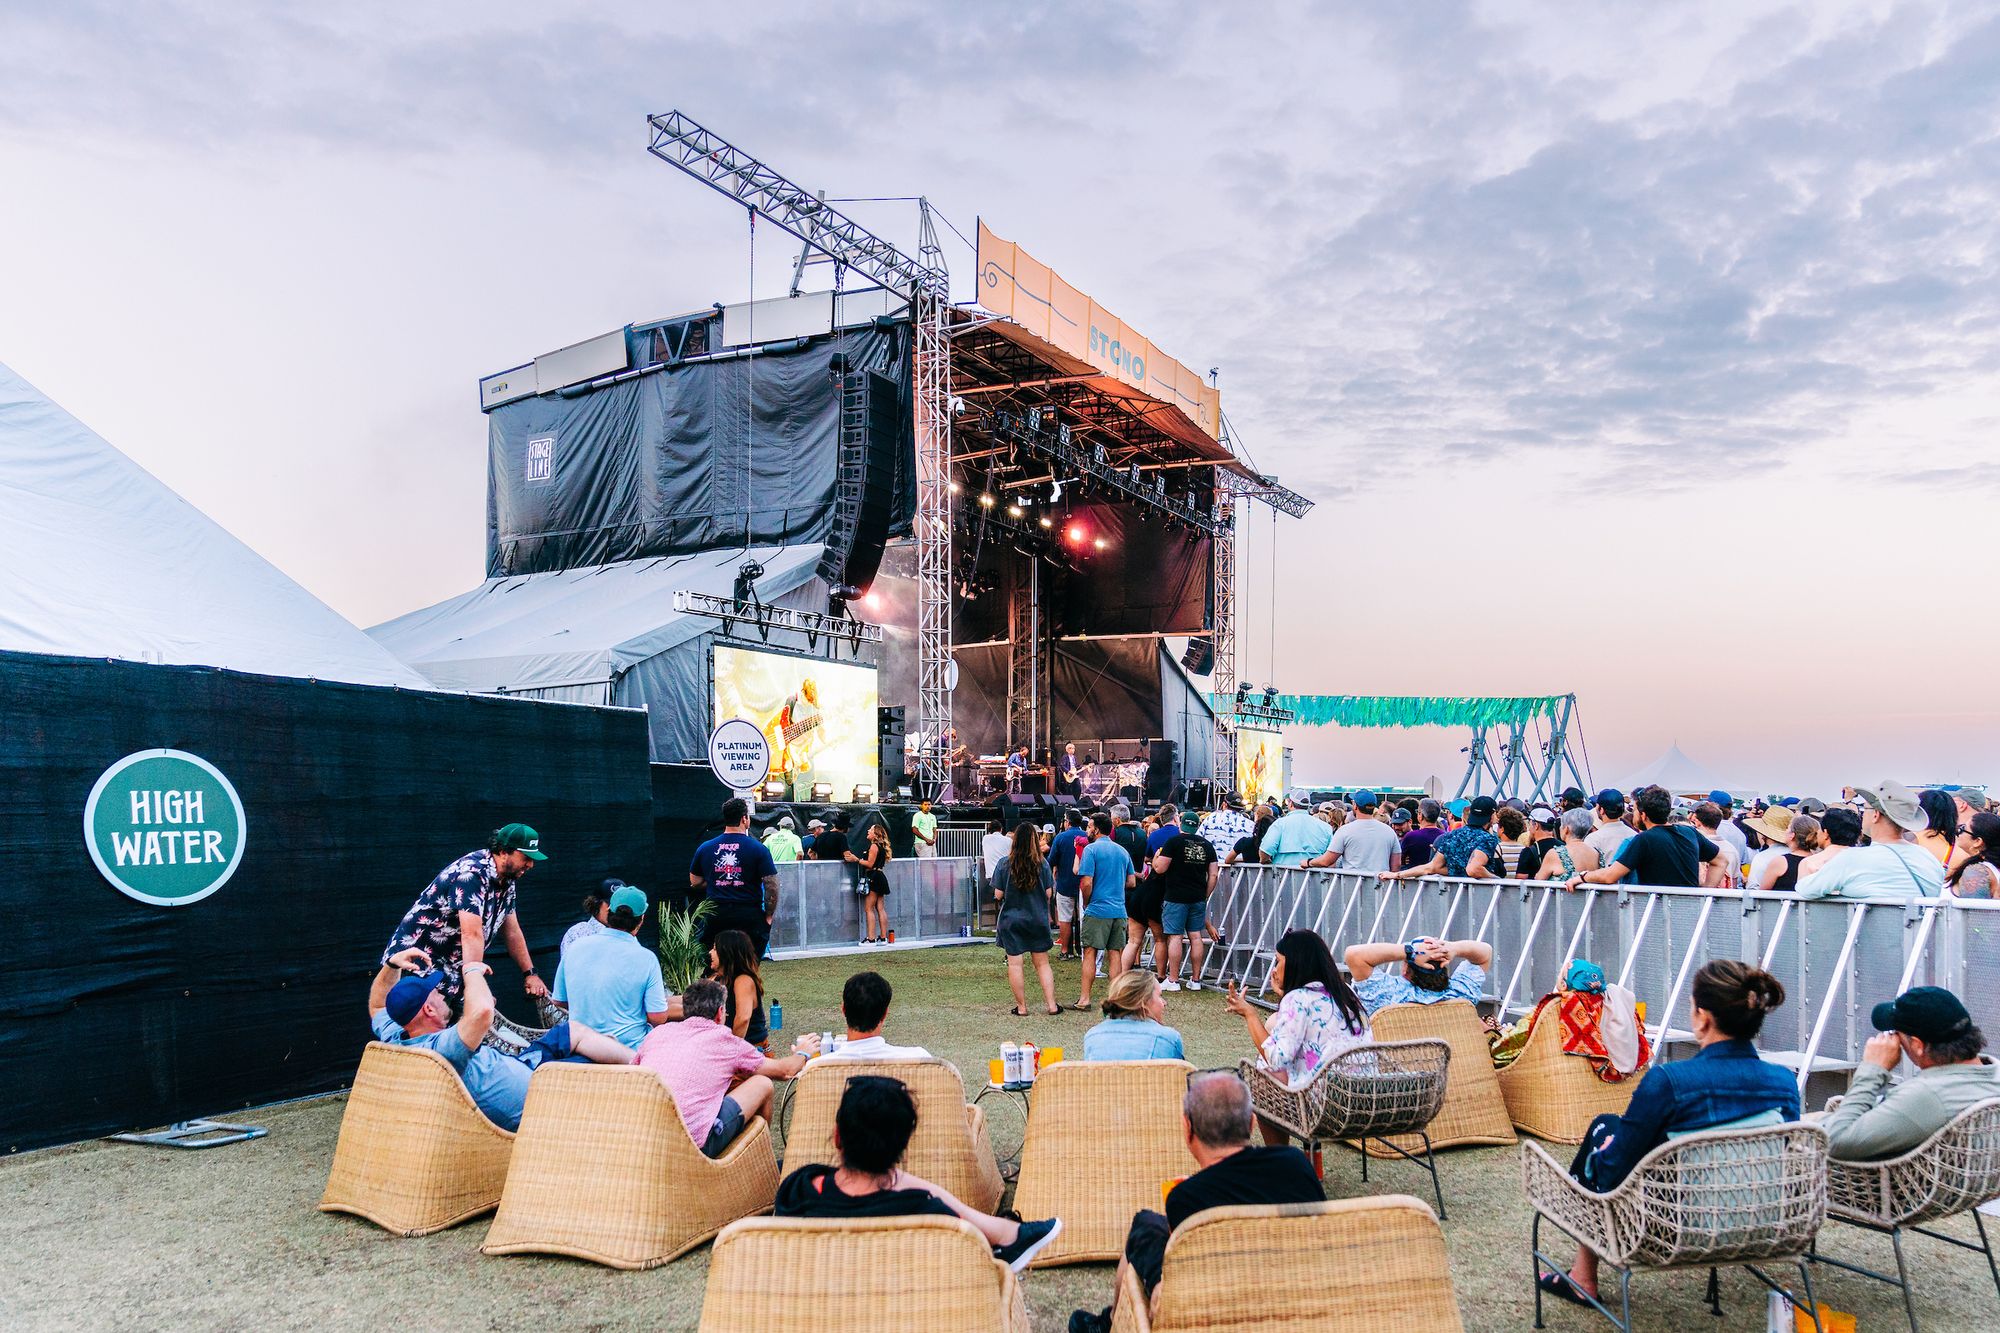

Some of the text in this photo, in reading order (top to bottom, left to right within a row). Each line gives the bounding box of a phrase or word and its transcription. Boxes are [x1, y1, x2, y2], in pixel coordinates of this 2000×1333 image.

[1089, 325, 1145, 381] STONO
[530, 441, 550, 460] STAGE
[529, 459, 549, 478] LINE
[717, 742, 762, 750] PLATINUM
[721, 752, 761, 761] VIEWING
[729, 763, 754, 771] AREA
[129, 789, 205, 825] HIGH
[110, 830, 226, 867] WATER
